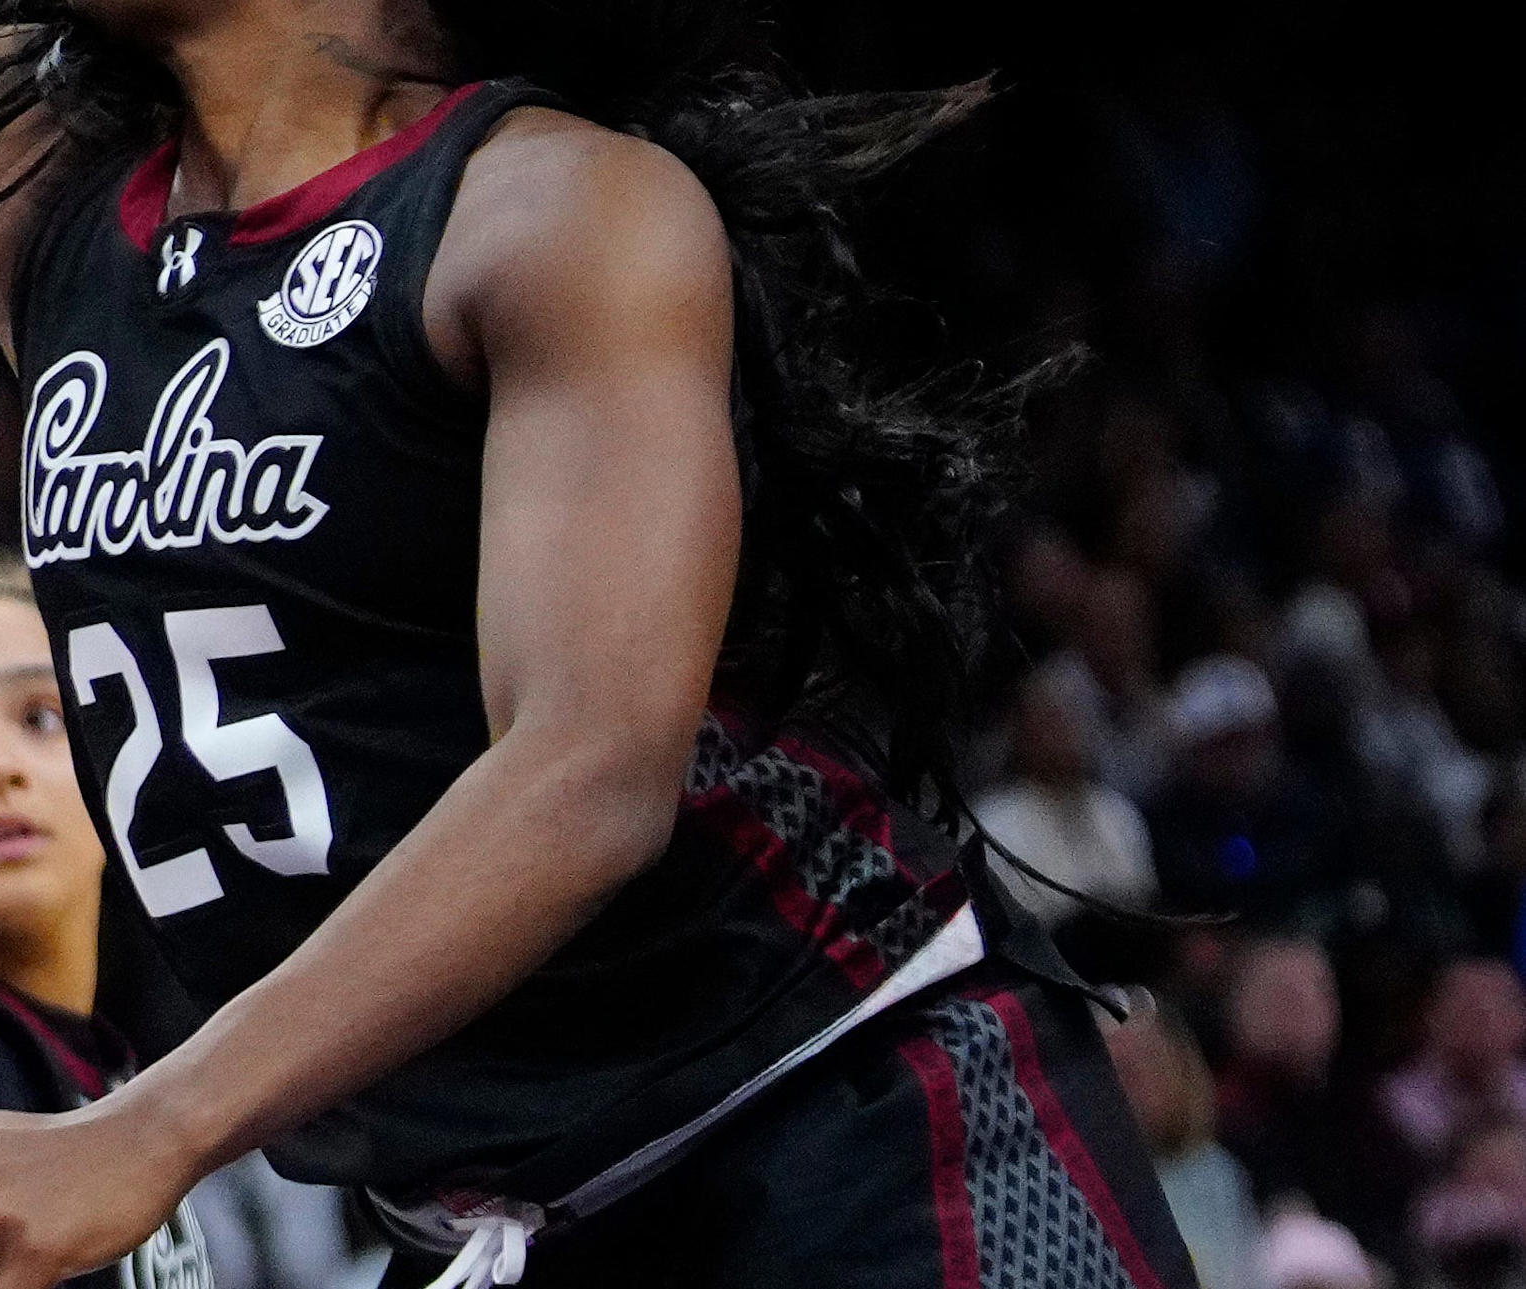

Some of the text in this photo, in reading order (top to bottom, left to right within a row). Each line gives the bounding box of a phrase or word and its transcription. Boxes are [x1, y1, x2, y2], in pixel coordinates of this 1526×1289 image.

[267, 301, 361, 345] GRADUATE
[289, 226, 375, 316] SEC
[20, 337, 331, 570] Carolina
[68, 604, 334, 919] 25
